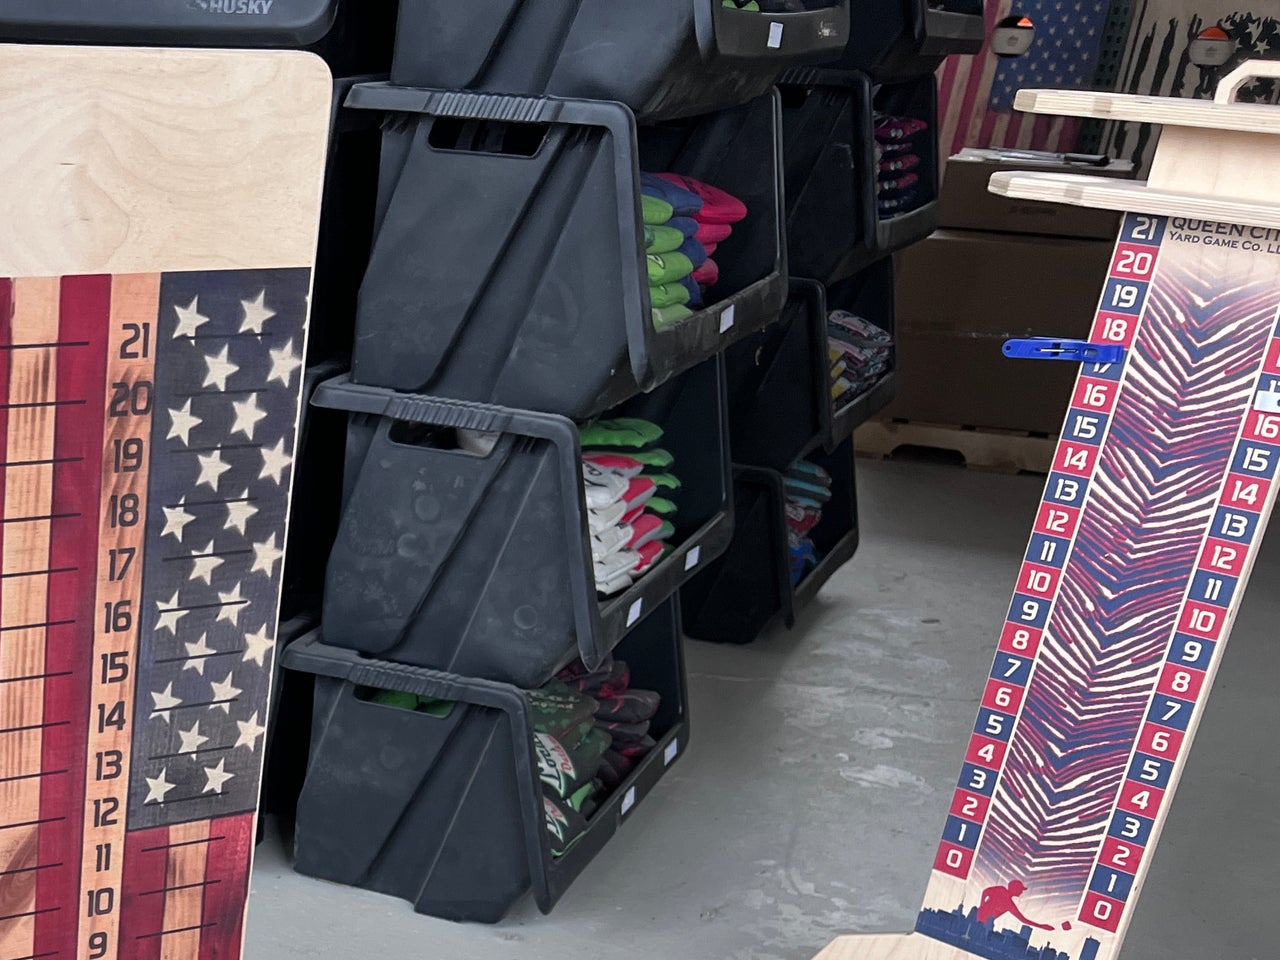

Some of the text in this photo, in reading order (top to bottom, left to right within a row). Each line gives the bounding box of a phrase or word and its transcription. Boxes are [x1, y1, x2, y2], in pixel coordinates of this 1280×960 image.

[209, 0, 273, 14] HUSKY
[1131, 217, 1159, 241] 21
[1172, 217, 1245, 237] QUEEN
[1169, 231, 1200, 243] YARD
[1203, 236, 1239, 248] GAME
[1116, 251, 1153, 275] 20
[1111, 285, 1138, 308] 19
[1101, 318, 1127, 340] 18
[120, 323, 150, 358] 21
[110, 381, 153, 417] 20
[1083, 384, 1108, 406] 16
[1073, 417, 1098, 438] 15
[1253, 413, 1279, 438] 16
[114, 438, 143, 473] 19
[1063, 448, 1089, 470] 14
[1242, 447, 1270, 472] 15
[1054, 479, 1079, 501] 13
[1231, 480, 1259, 505] 14
[110, 493, 139, 528] 18
[1045, 509, 1069, 532] 12
[1221, 513, 1248, 537] 13
[1040, 541, 1057, 562] 11
[1211, 545, 1237, 570] 12
[109, 547, 136, 581] 17
[1026, 570, 1051, 592] 10
[1204, 578, 1223, 600] 11
[104, 600, 132, 633] 16
[1021, 601, 1040, 621] 9
[1187, 608, 1216, 632] 10
[1011, 630, 1030, 650] 8
[1182, 641, 1202, 662] 9
[101, 651, 129, 684] 15
[1003, 658, 1021, 679] 7
[1171, 671, 1191, 693] 8
[994, 687, 1012, 707] 6
[98, 701, 126, 733] 14
[1161, 701, 1181, 722] 7
[985, 715, 1004, 735] 5
[977, 743, 995, 762] 4
[1151, 731, 1170, 752] 6
[96, 750, 122, 781] 13
[1140, 760, 1160, 781] 5
[969, 769, 987, 789] 3
[961, 796, 978, 816] 2
[1131, 790, 1150, 810] 4
[93, 797, 119, 827] 12
[957, 823, 967, 842] 1
[1121, 817, 1140, 838] 3
[95, 843, 111, 872] 11
[946, 849, 962, 869] 0
[1112, 845, 1130, 866] 2
[1106, 873, 1117, 892] 1
[87, 887, 114, 917] 10
[1093, 904, 1112, 921] 0
[89, 932, 107, 959] 9
